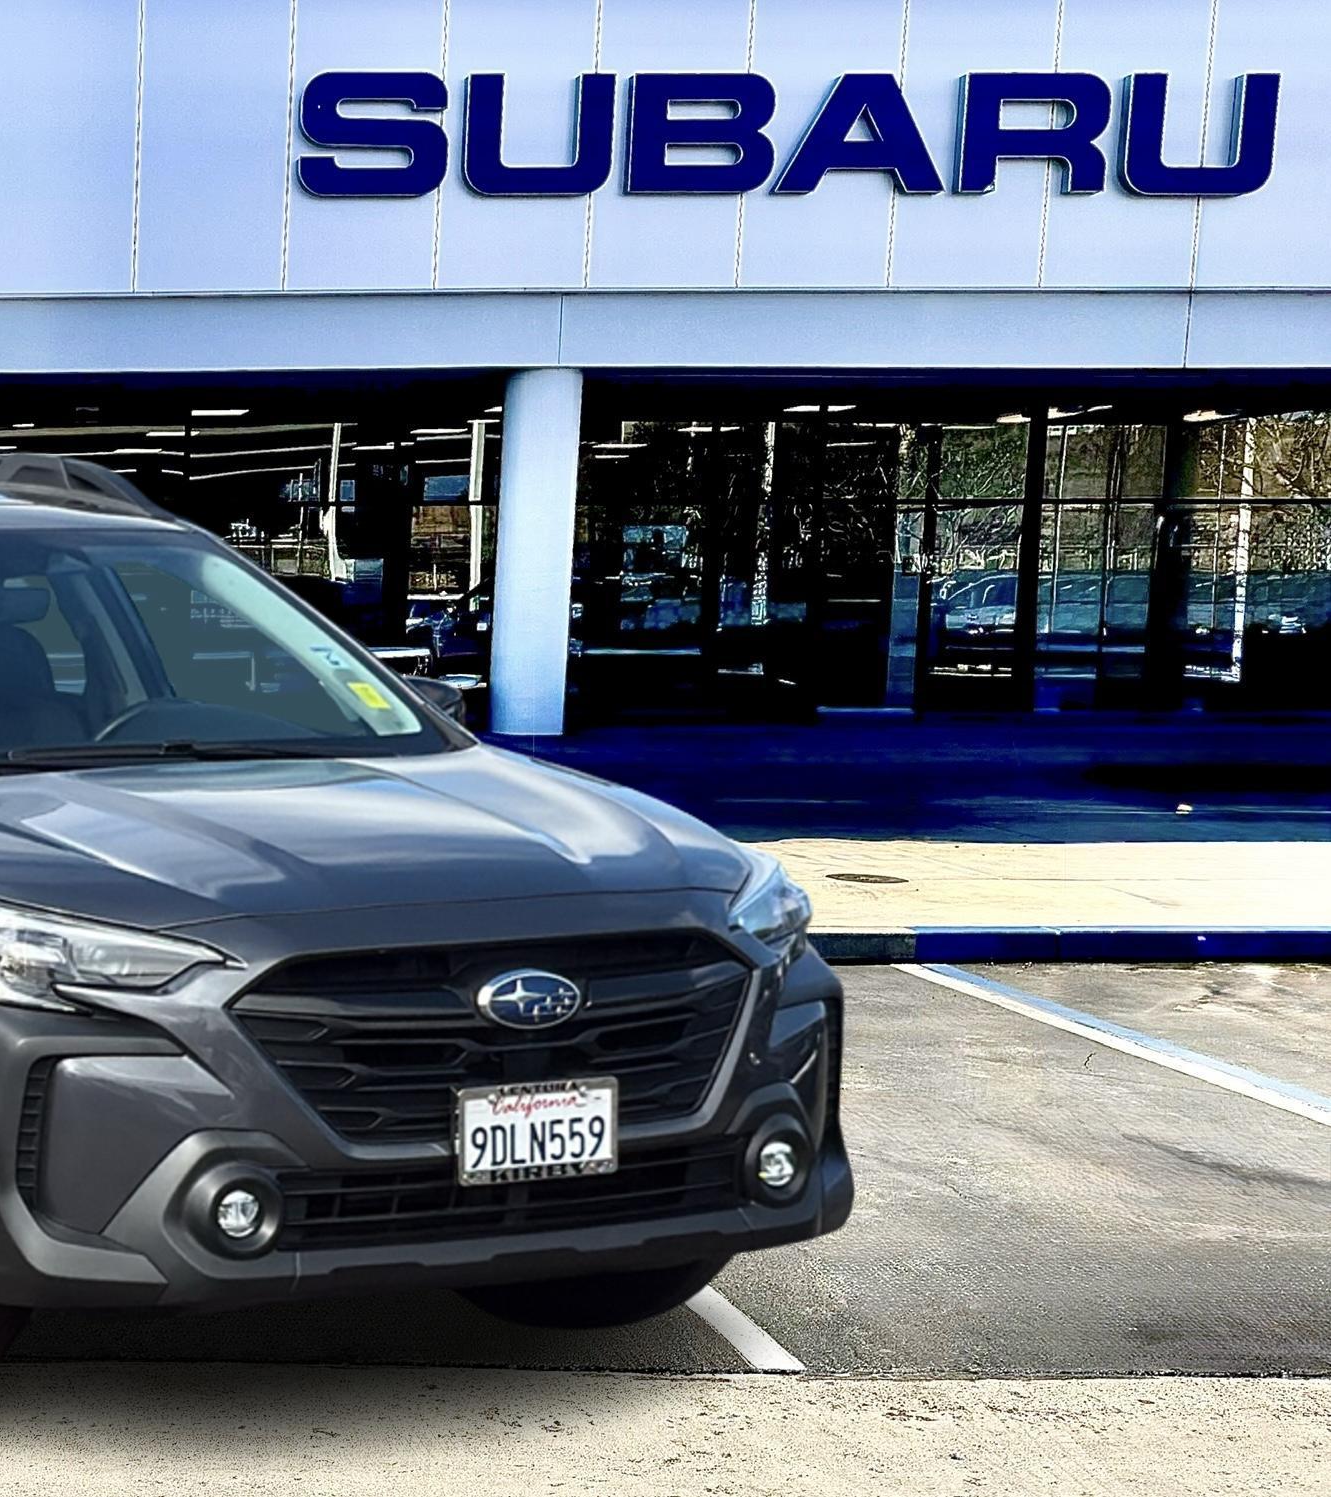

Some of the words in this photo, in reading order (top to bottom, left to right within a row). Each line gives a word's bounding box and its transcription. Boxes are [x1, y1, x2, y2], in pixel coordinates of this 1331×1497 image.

[297, 72, 1281, 197] SUBARU
[493, 1094, 577, 1118] California
[472, 1116, 605, 1168] 9DLN559
[490, 1161, 584, 1182] KIRBY
